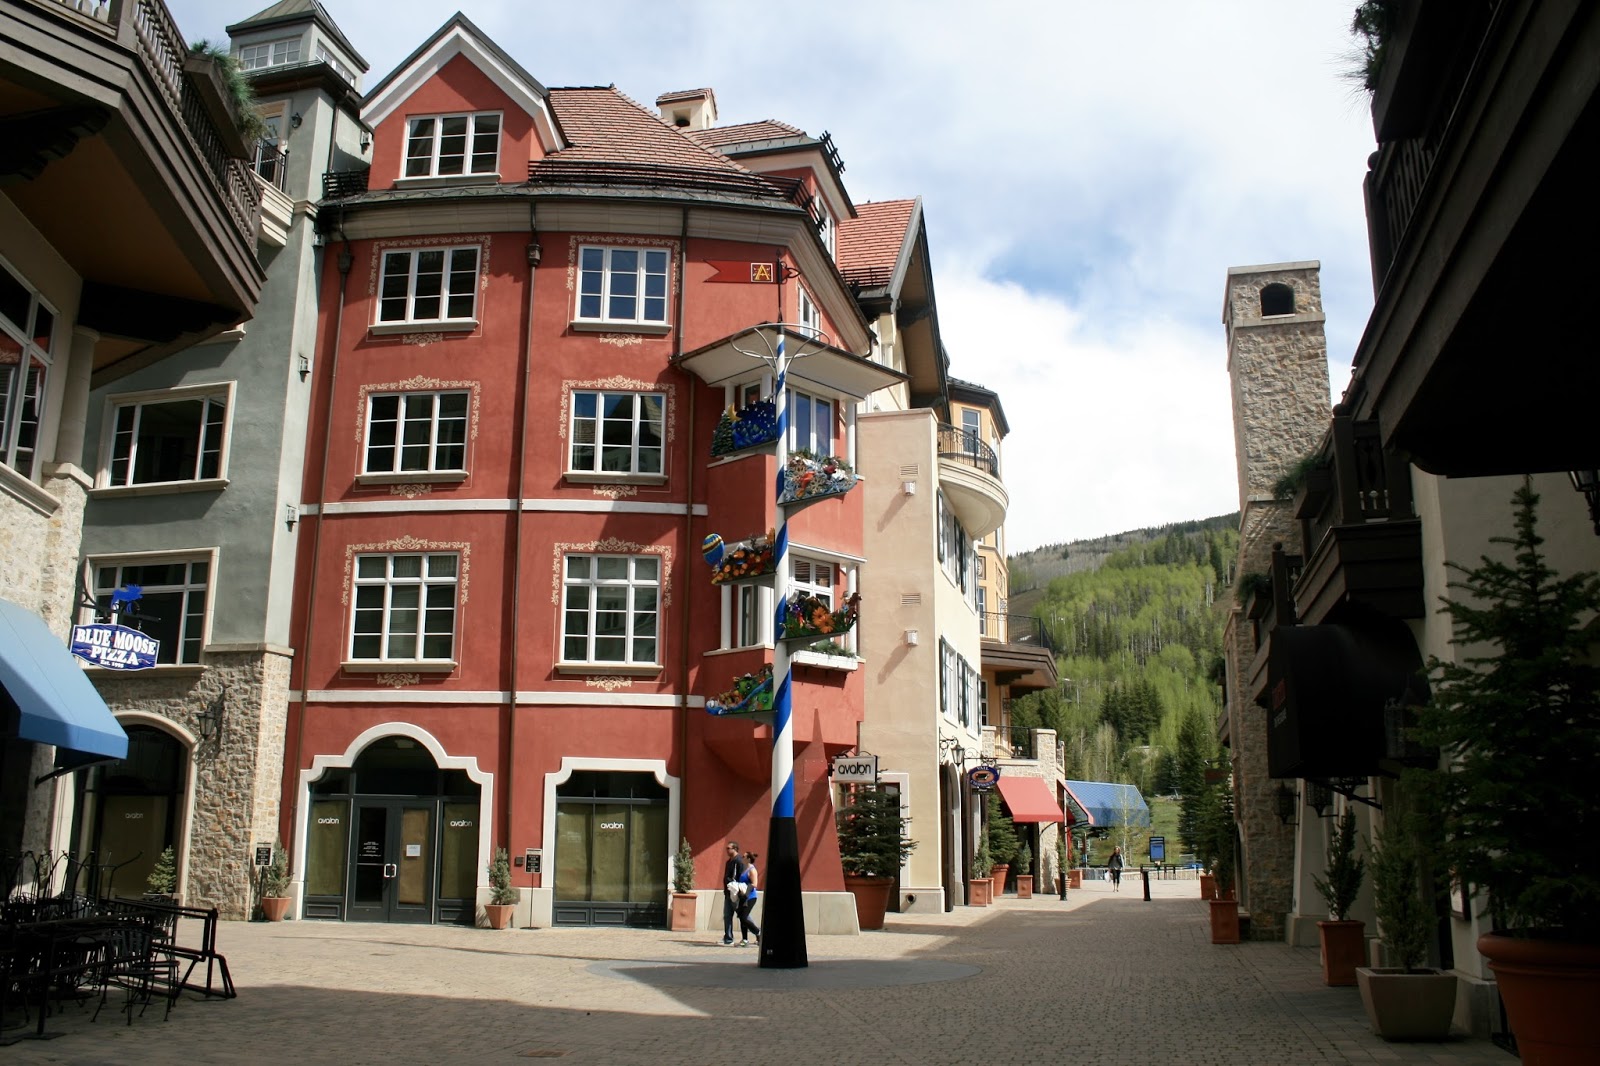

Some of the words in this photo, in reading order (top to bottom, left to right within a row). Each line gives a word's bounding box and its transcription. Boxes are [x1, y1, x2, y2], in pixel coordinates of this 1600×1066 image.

[754, 264, 770, 281] A
[75, 628, 112, 648] BLUE
[113, 630, 157, 656] MOOSE
[90, 645, 139, 666] PIZZA
[838, 762, 872, 776] avalon
[318, 817, 340, 825] avalon
